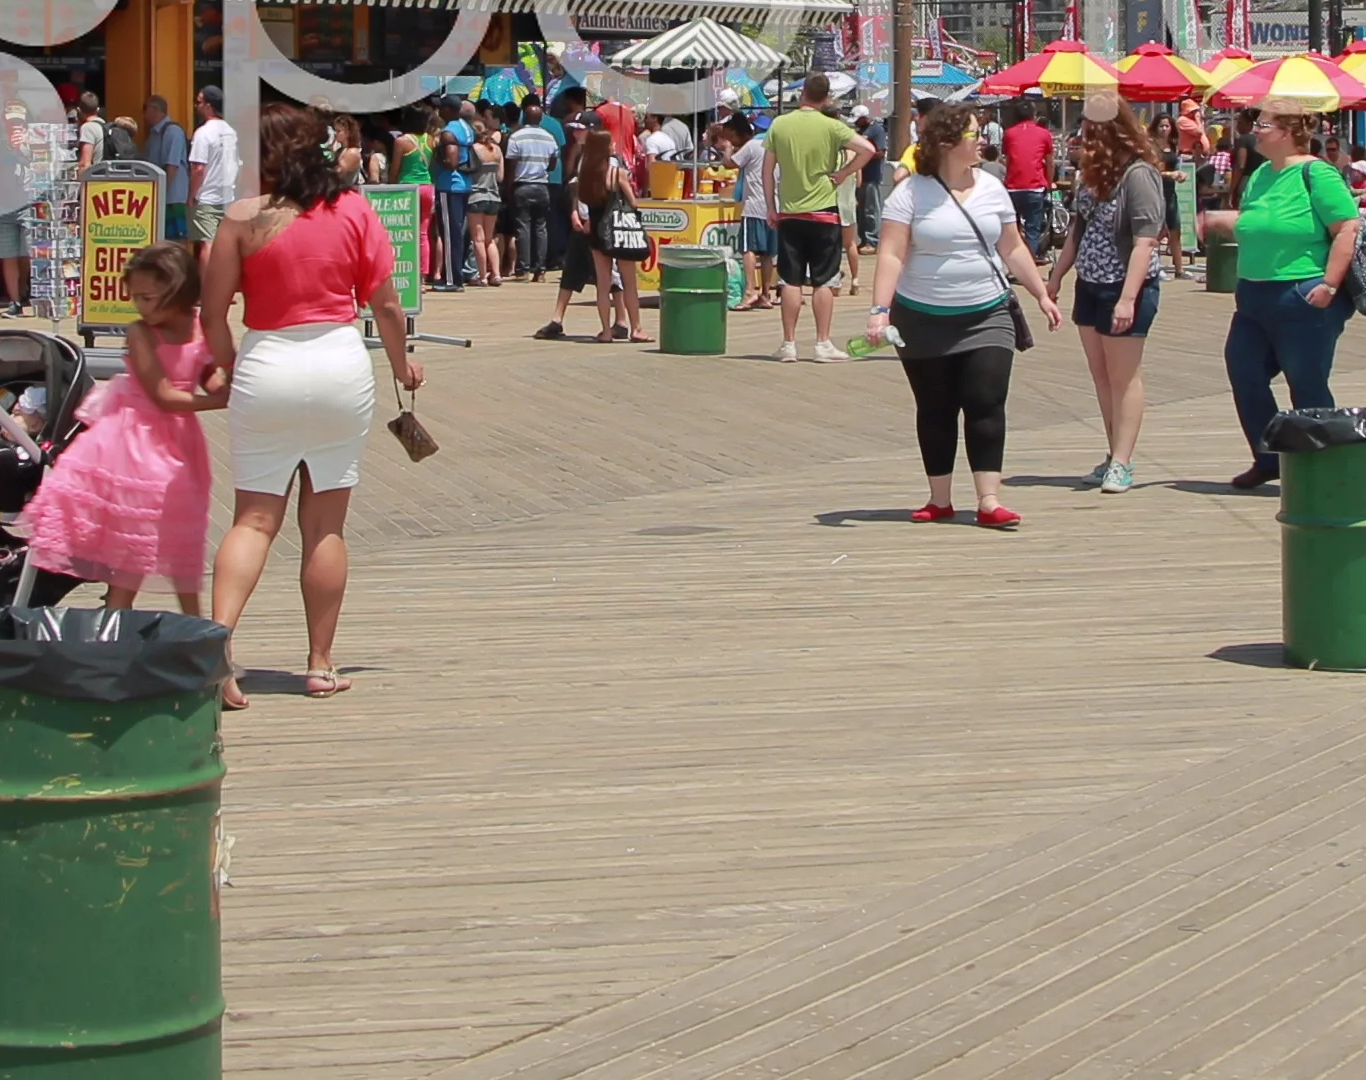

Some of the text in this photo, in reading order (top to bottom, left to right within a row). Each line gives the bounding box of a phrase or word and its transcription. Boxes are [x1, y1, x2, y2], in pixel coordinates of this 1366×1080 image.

[92, 189, 149, 219] NEW
[371, 198, 412, 211] PLEASE
[613, 230, 647, 249] PINK
